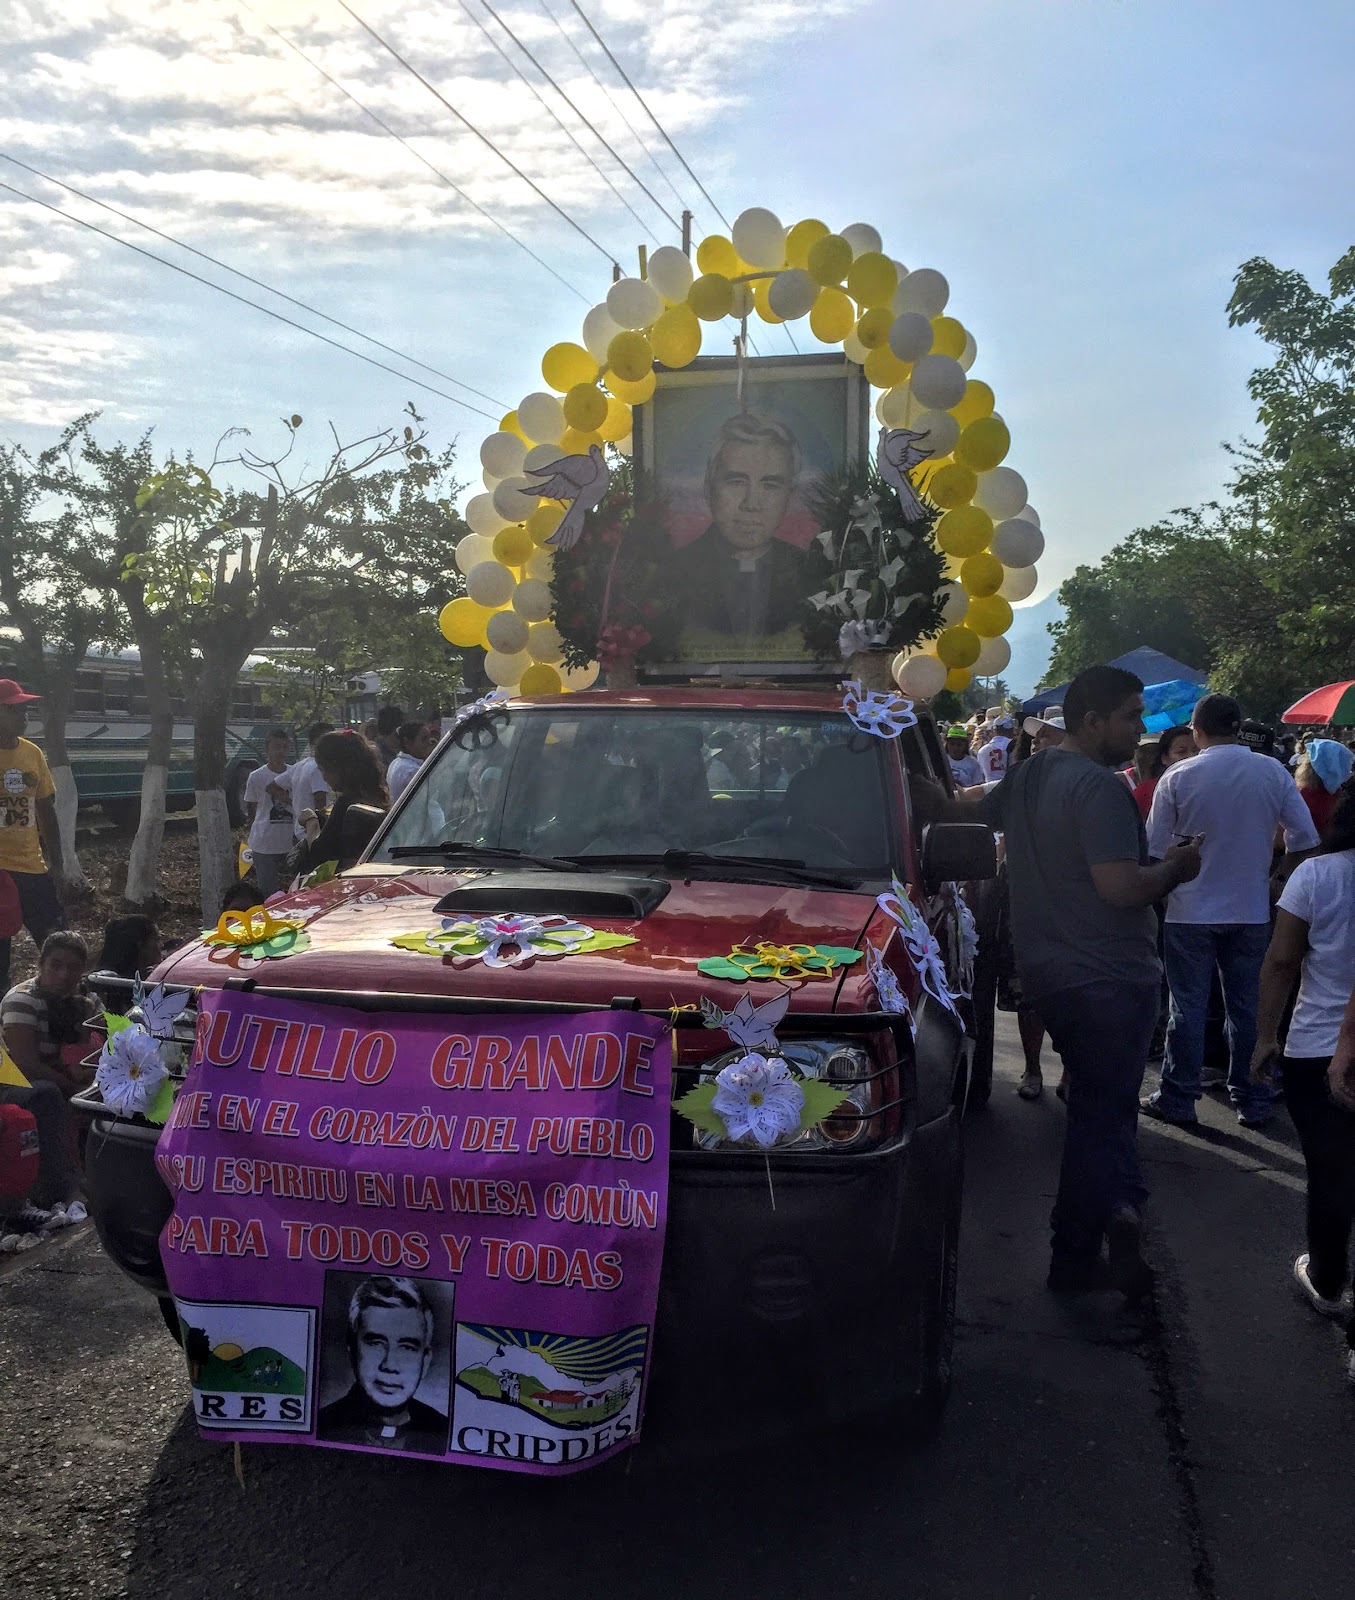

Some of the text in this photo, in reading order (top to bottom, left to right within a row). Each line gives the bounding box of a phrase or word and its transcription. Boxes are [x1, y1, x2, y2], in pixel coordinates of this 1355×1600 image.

[430, 1031, 656, 1095] GRANDE
[216, 1094, 261, 1133] EN
[262, 1100, 301, 1137] EL
[460, 1115, 520, 1154] DEL
[527, 1116, 656, 1162] PUEBLO
[172, 1154, 206, 1192] SU
[213, 1155, 348, 1203] ESPIRITU
[355, 1171, 402, 1208] EN
[403, 1175, 443, 1211] LA
[451, 1178, 537, 1218] MESA
[167, 1213, 625, 1291] PARA TODOS Y TODAS
[200, 1393, 303, 1420] RES
[456, 1413, 632, 1464] CRIPDES
